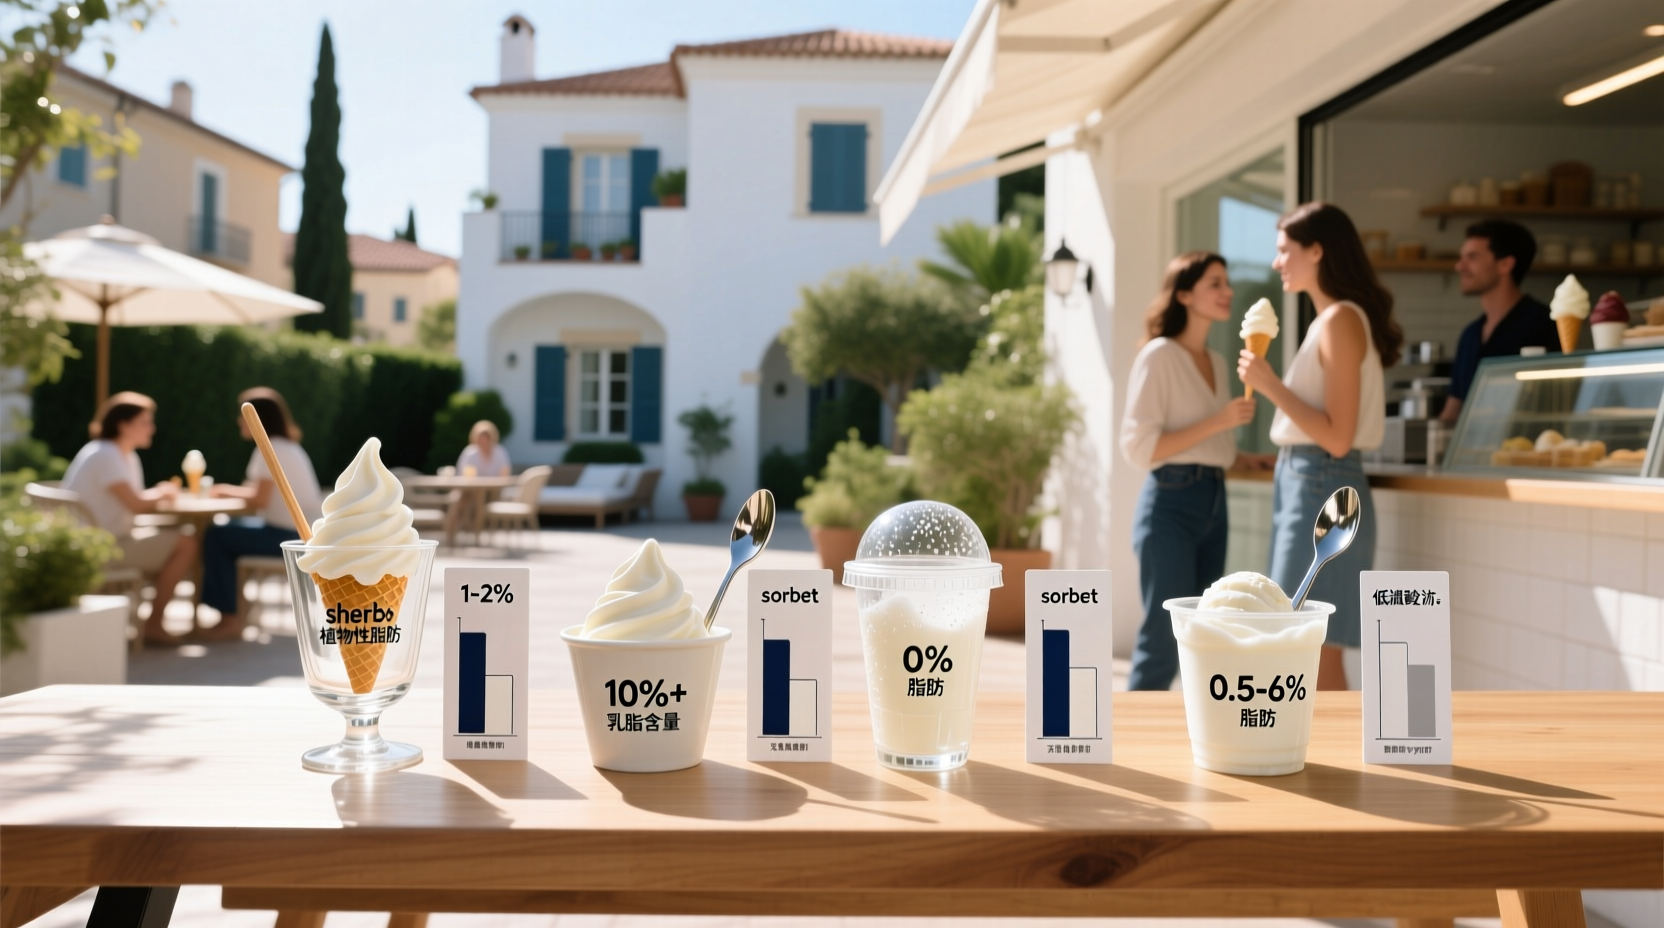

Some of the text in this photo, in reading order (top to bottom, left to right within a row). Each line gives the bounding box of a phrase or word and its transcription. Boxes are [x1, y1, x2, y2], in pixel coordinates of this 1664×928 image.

[460, 583, 515, 604] 1-2%
[761, 587, 819, 604] sorbet
[1041, 588, 1099, 604] sorbet
[319, 624, 402, 645] 植物性脂肪
[902, 645, 953, 673] 0%
[604, 679, 687, 708] 10%+
[907, 677, 945, 697] 脂肪
[1209, 674, 1307, 702] 0.5-6%
[607, 712, 681, 732] 乳脂含量
[1240, 708, 1277, 728] 脂肪
